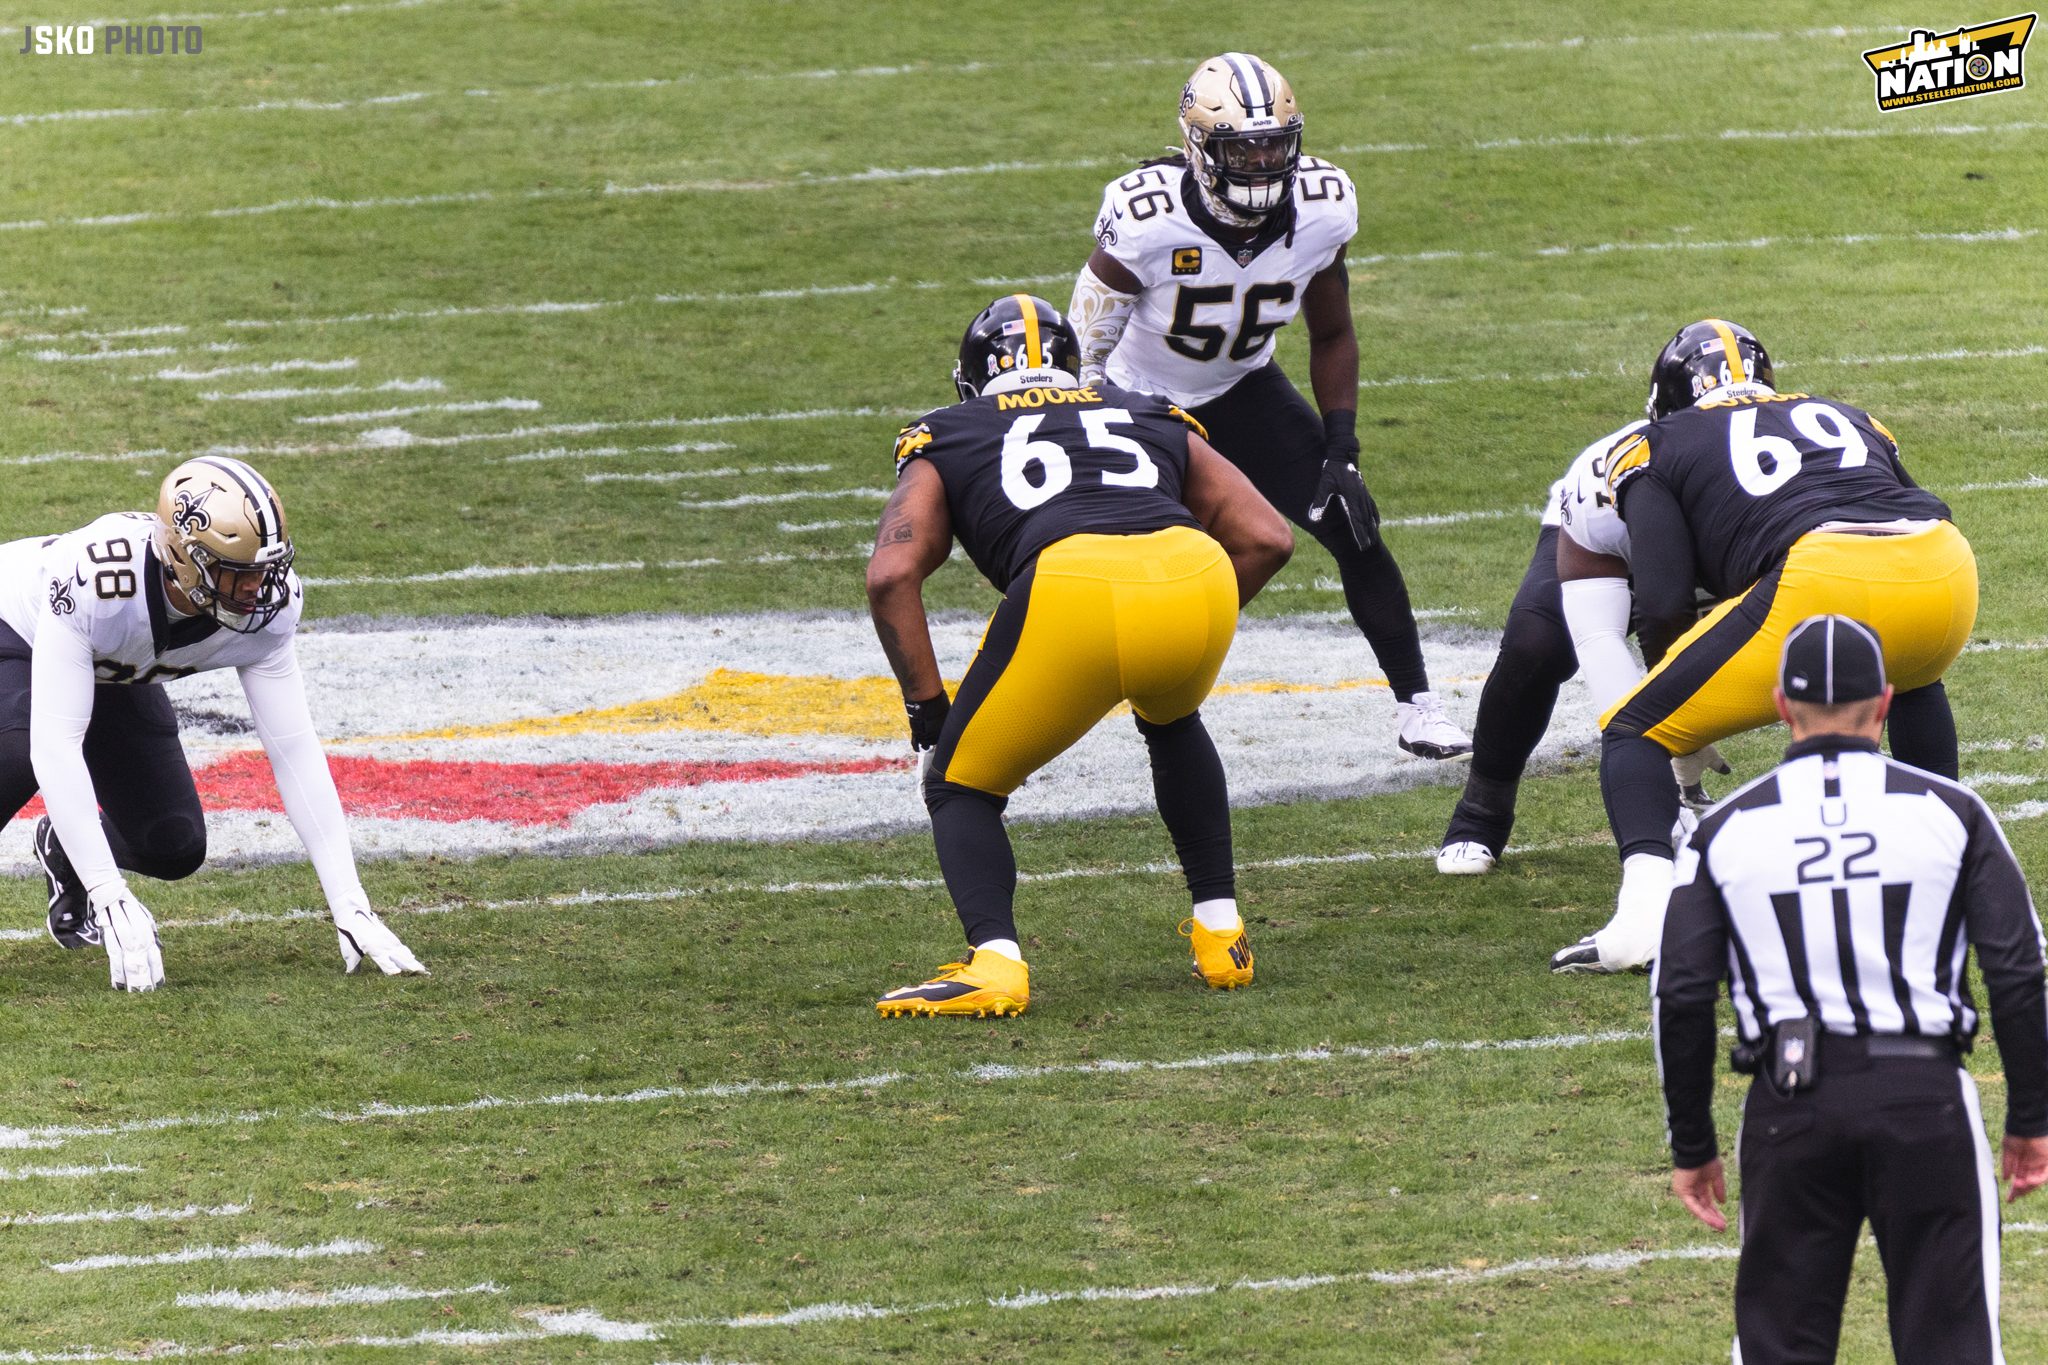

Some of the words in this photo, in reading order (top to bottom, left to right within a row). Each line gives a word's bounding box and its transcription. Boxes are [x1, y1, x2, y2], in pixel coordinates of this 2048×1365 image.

[1119, 170, 1174, 222] 56
[1174, 249, 1201, 269] C
[1162, 281, 1296, 362] 56
[997, 386, 1103, 411] MOORE
[1020, 373, 1054, 385] Steelers
[1001, 408, 1159, 510] 65
[1729, 402, 1869, 497] 69
[86, 537, 137, 600] 98
[1820, 803, 1847, 827] U
[1794, 831, 1880, 885] 22
